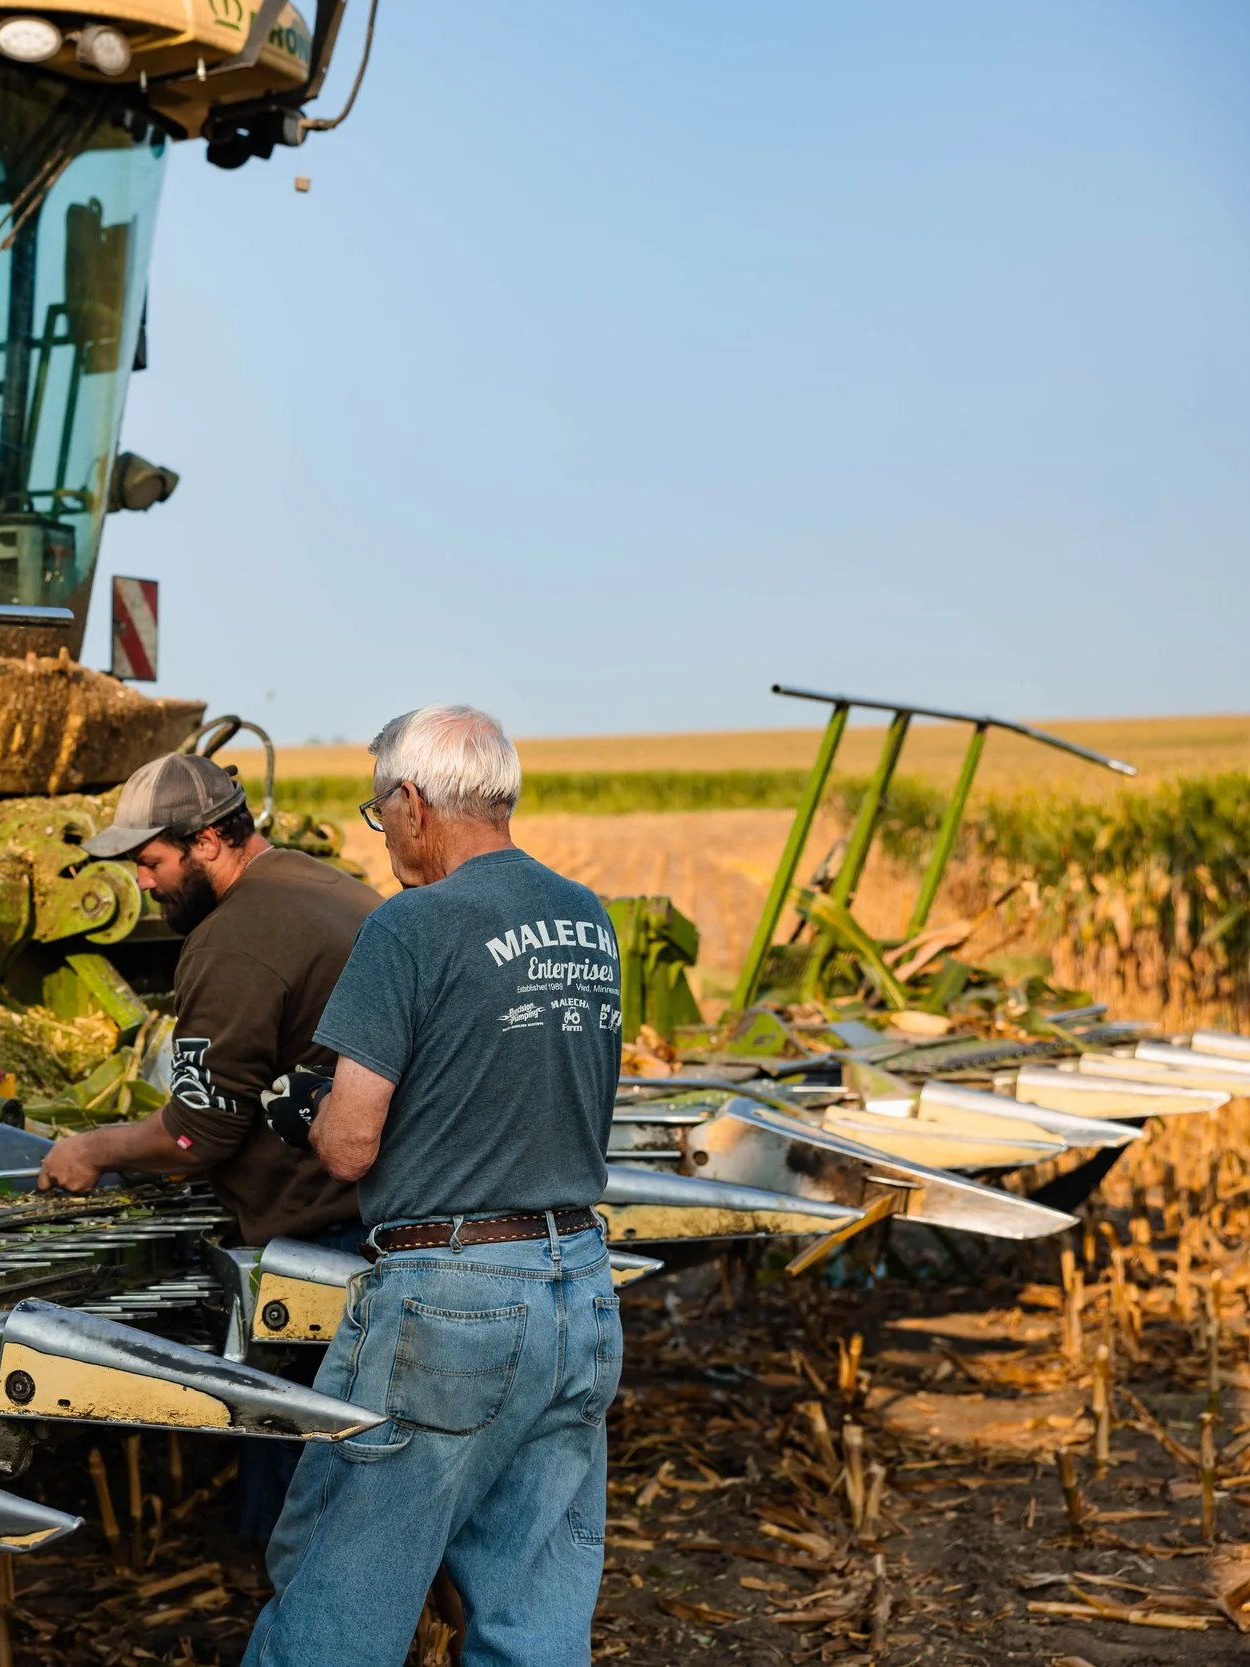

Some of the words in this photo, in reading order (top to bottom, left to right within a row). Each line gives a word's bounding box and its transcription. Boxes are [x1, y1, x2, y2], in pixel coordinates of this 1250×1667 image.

[528, 956, 613, 985] Enterprises
[551, 997, 590, 1010] MALECHA
[561, 1023, 583, 1032] Farm
